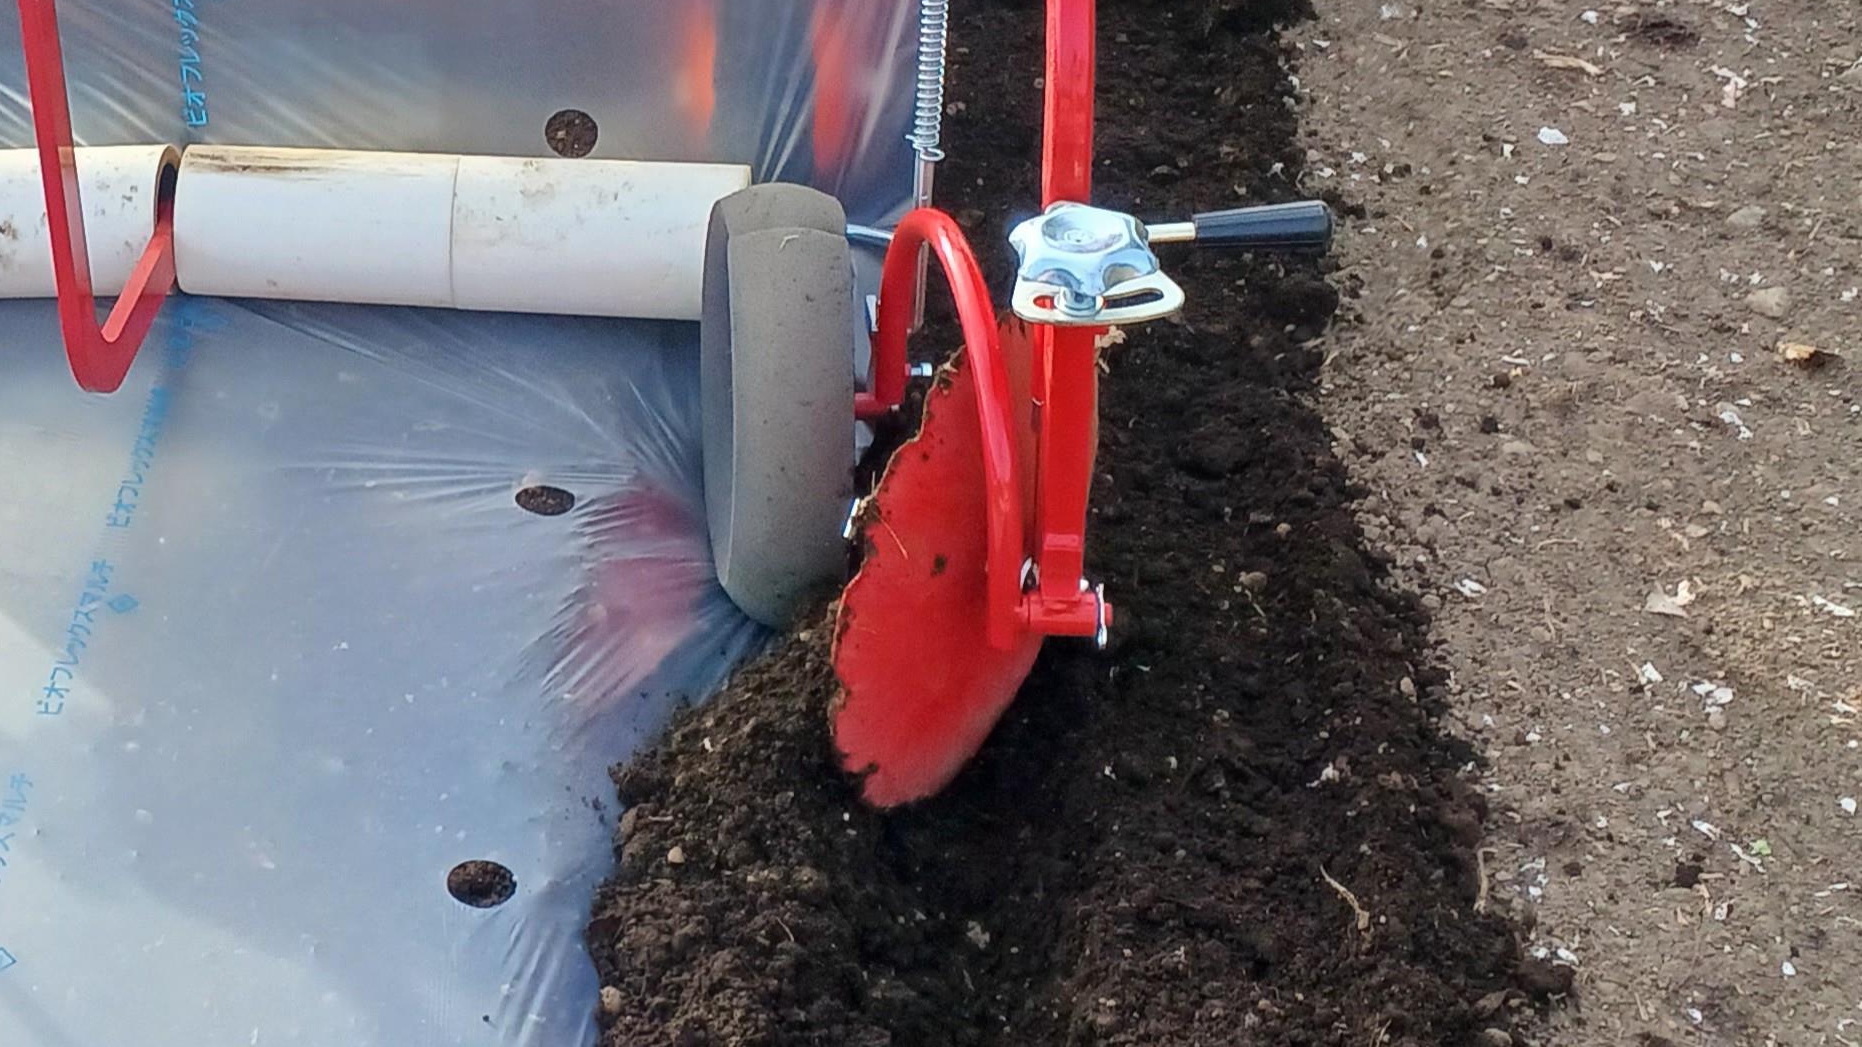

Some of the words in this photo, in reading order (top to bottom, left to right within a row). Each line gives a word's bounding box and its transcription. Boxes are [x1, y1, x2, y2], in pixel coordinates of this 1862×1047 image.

[37, 559, 114, 715] ビオフレックスマルチ
